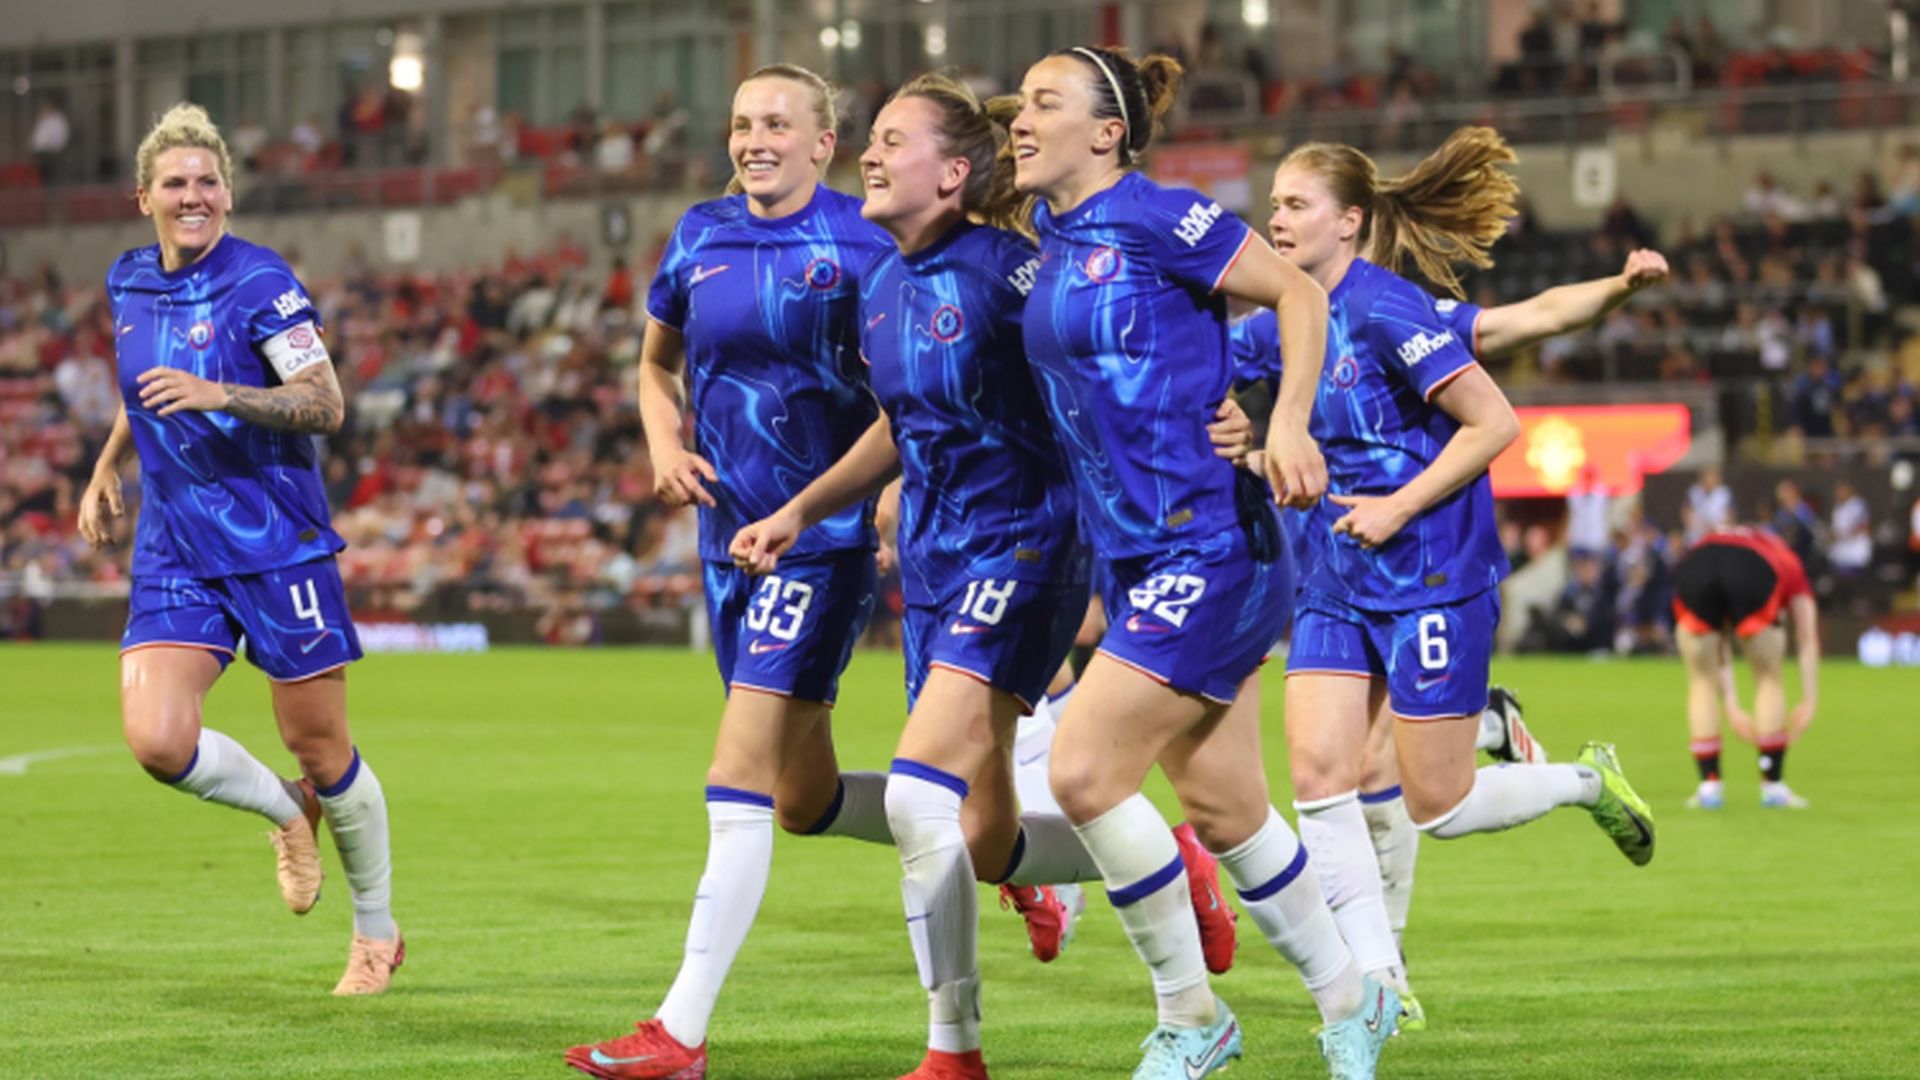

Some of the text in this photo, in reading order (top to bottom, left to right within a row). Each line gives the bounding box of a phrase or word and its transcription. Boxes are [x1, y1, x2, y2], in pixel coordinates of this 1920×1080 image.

[289, 578, 325, 630] 4
[747, 575, 813, 640] 33
[959, 579, 1018, 625] 18
[1128, 574, 1206, 628] 22
[1419, 613, 1449, 669] 6
